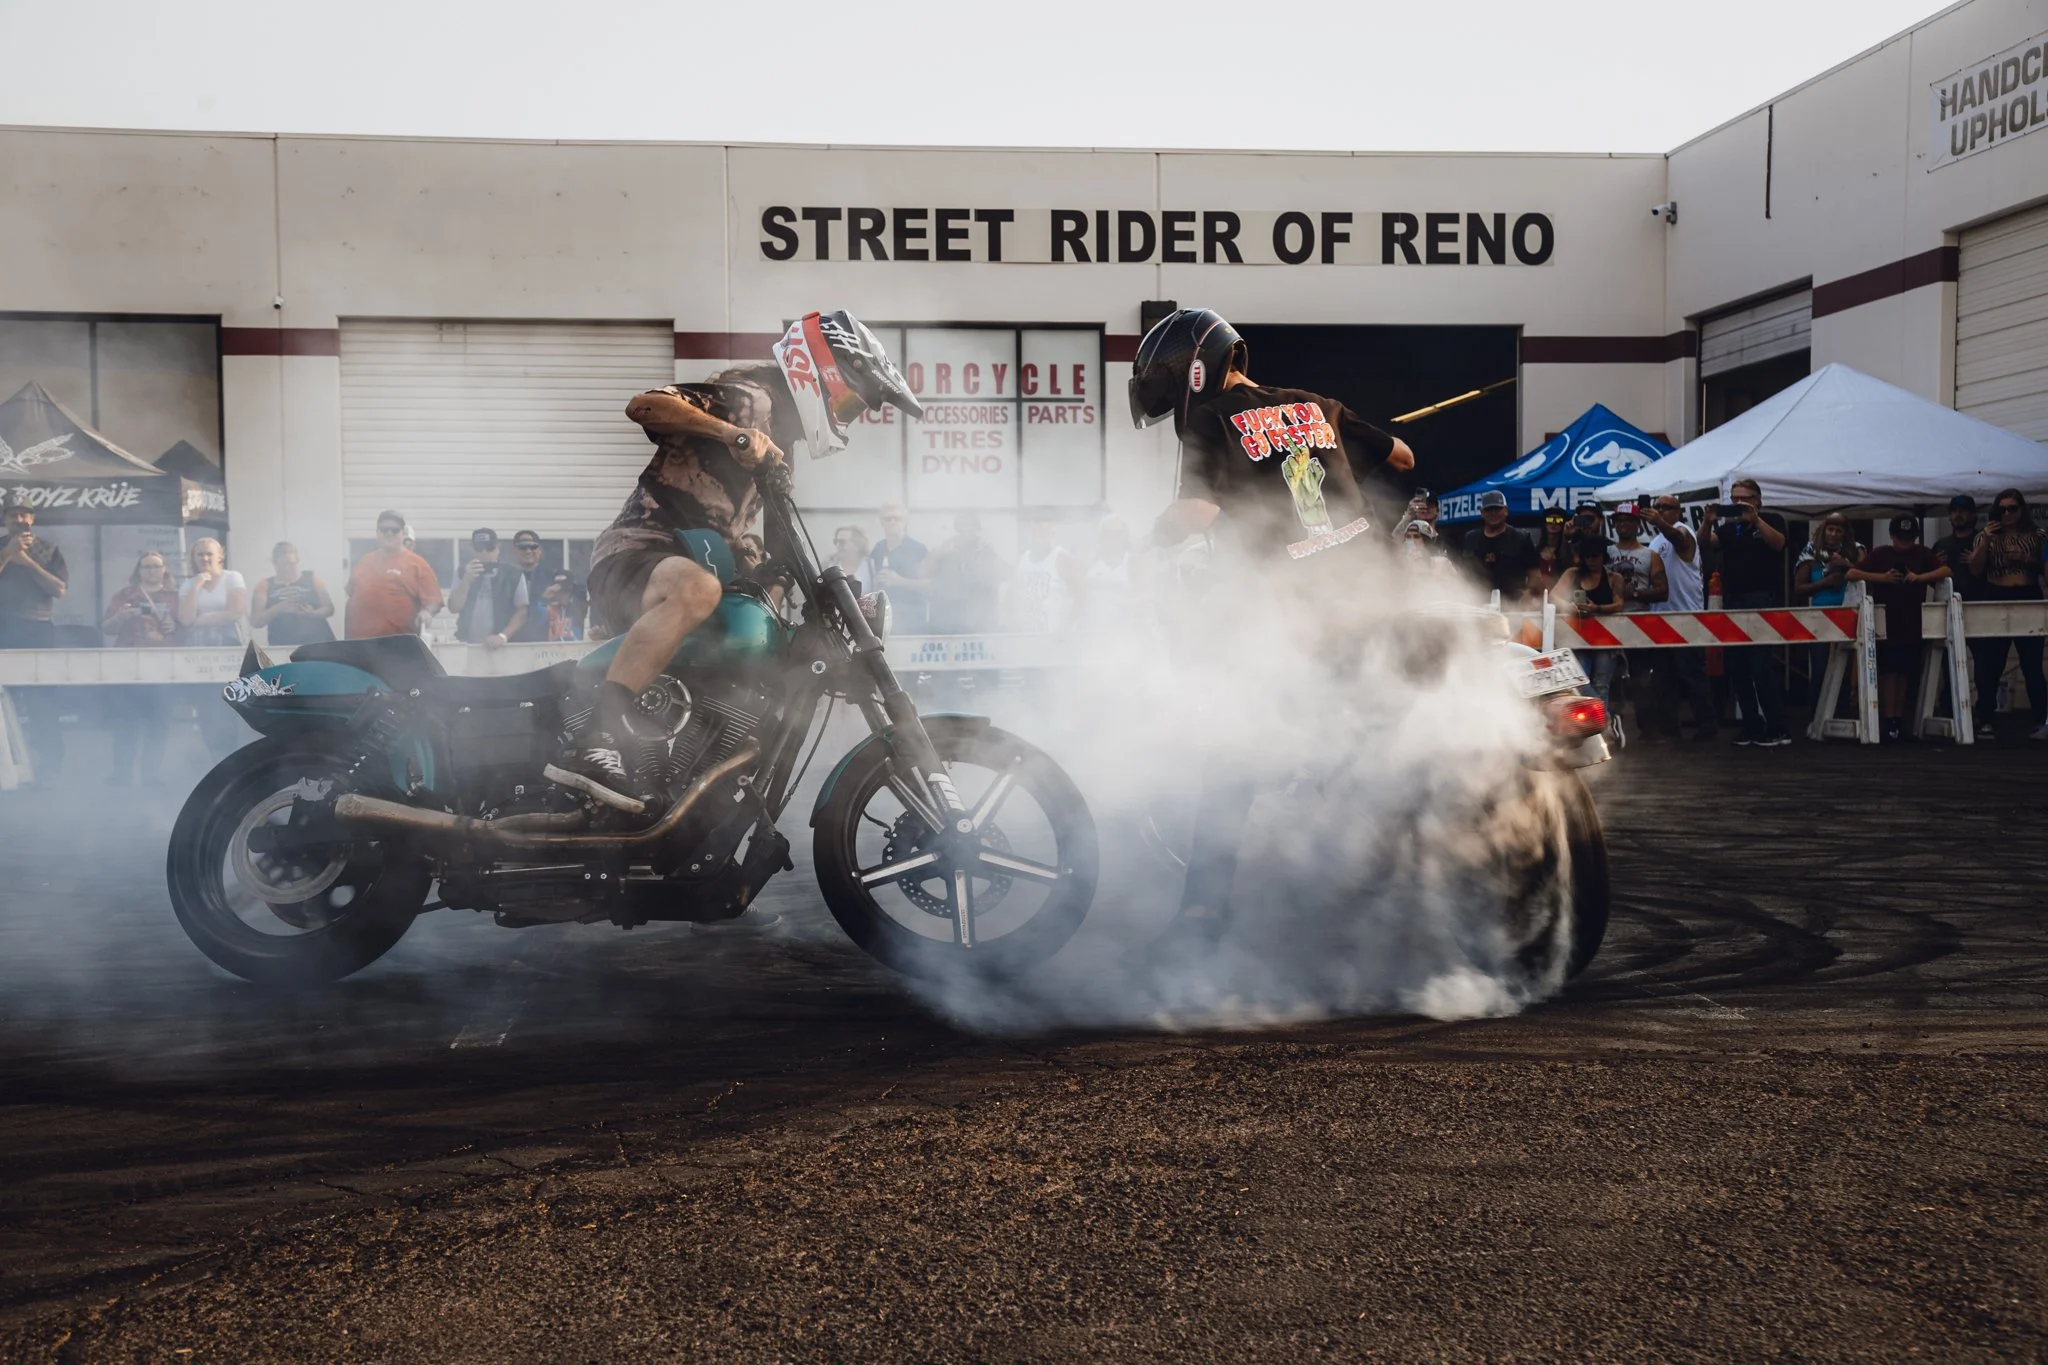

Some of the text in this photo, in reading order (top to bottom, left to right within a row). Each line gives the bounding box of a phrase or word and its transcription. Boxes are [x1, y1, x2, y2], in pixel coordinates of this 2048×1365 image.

[1951, 88, 2048, 156] UPHOL
[760, 205, 1555, 265] STREET RIDER OF RENO
[893, 362, 1086, 395] ORCYCLE
[859, 405, 895, 424] ICE
[1027, 405, 1095, 424] PARTS
[1230, 402, 1326, 436] FUCK YOU
[922, 430, 1003, 449] TIRES
[1241, 431, 1272, 461] GO
[922, 455, 1003, 475] DYNO
[1438, 492, 1483, 520] ETZELE
